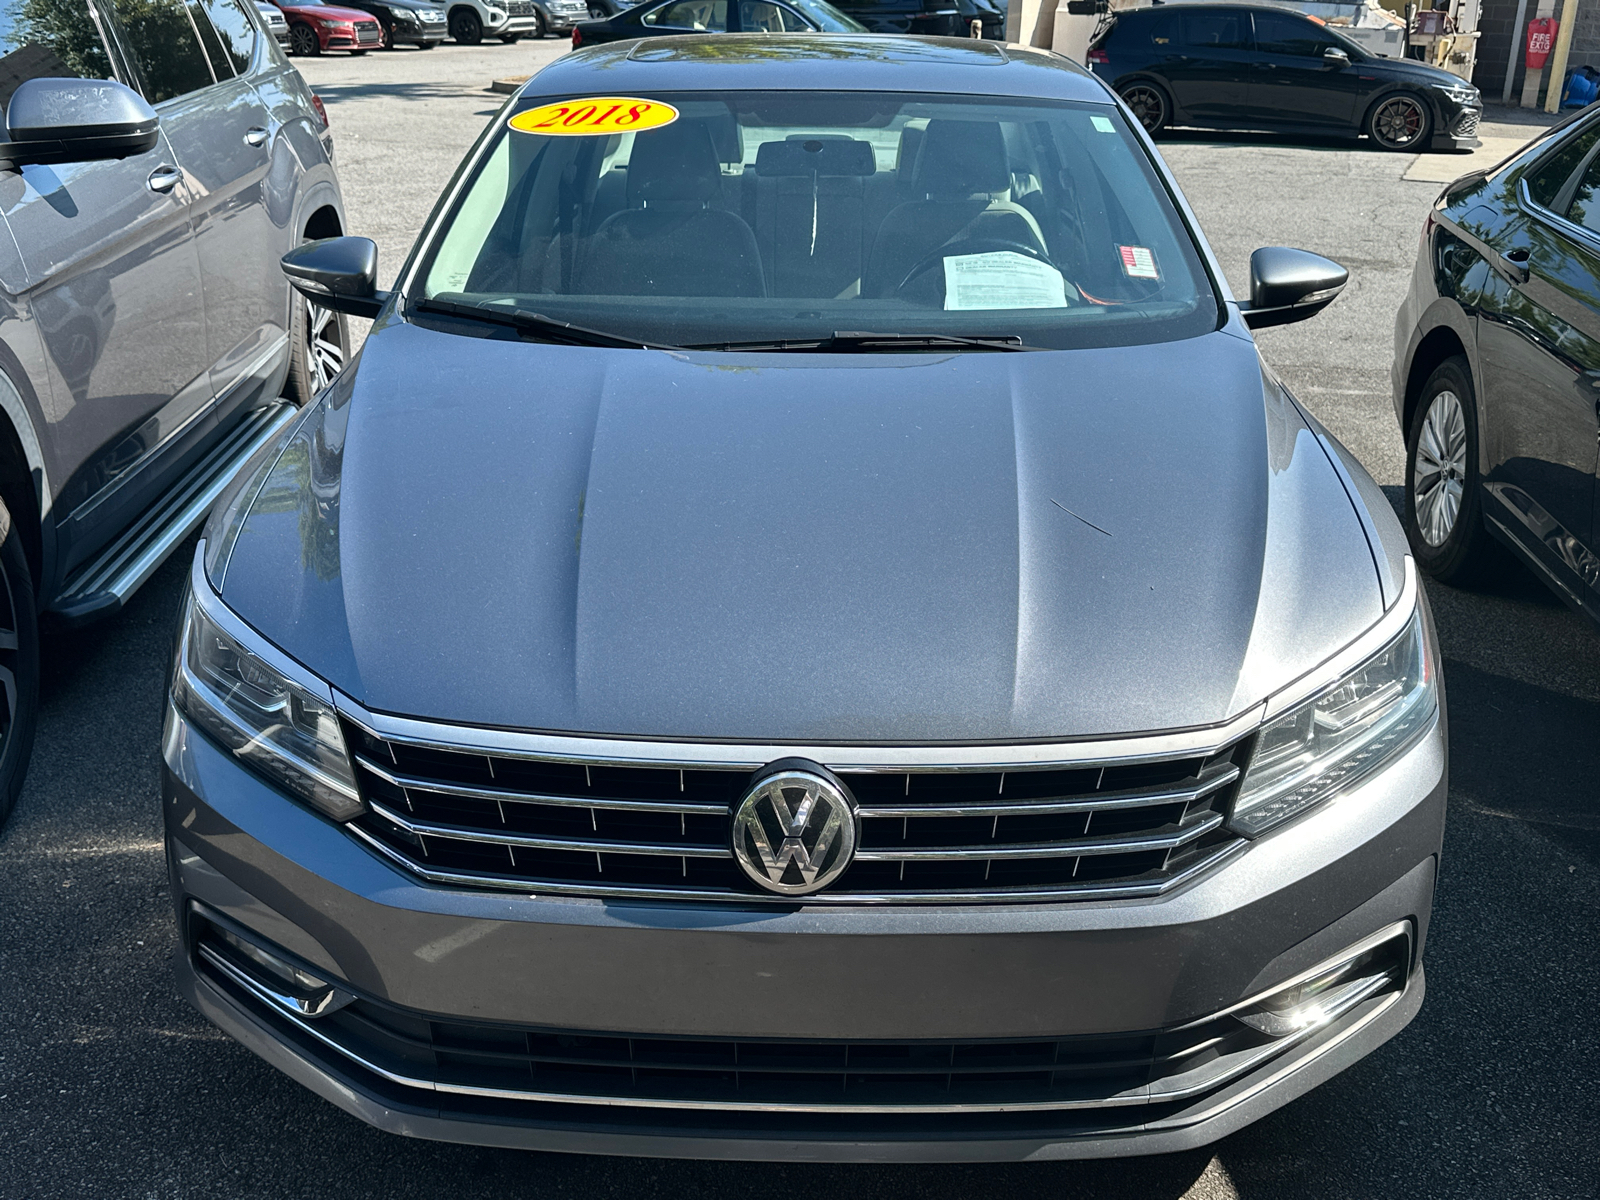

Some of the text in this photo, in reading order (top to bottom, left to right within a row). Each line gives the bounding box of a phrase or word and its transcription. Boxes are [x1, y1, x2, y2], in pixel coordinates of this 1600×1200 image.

[1532, 33, 1551, 42] FIRE
[531, 104, 652, 128] 2018
[738, 778, 850, 890] VW
